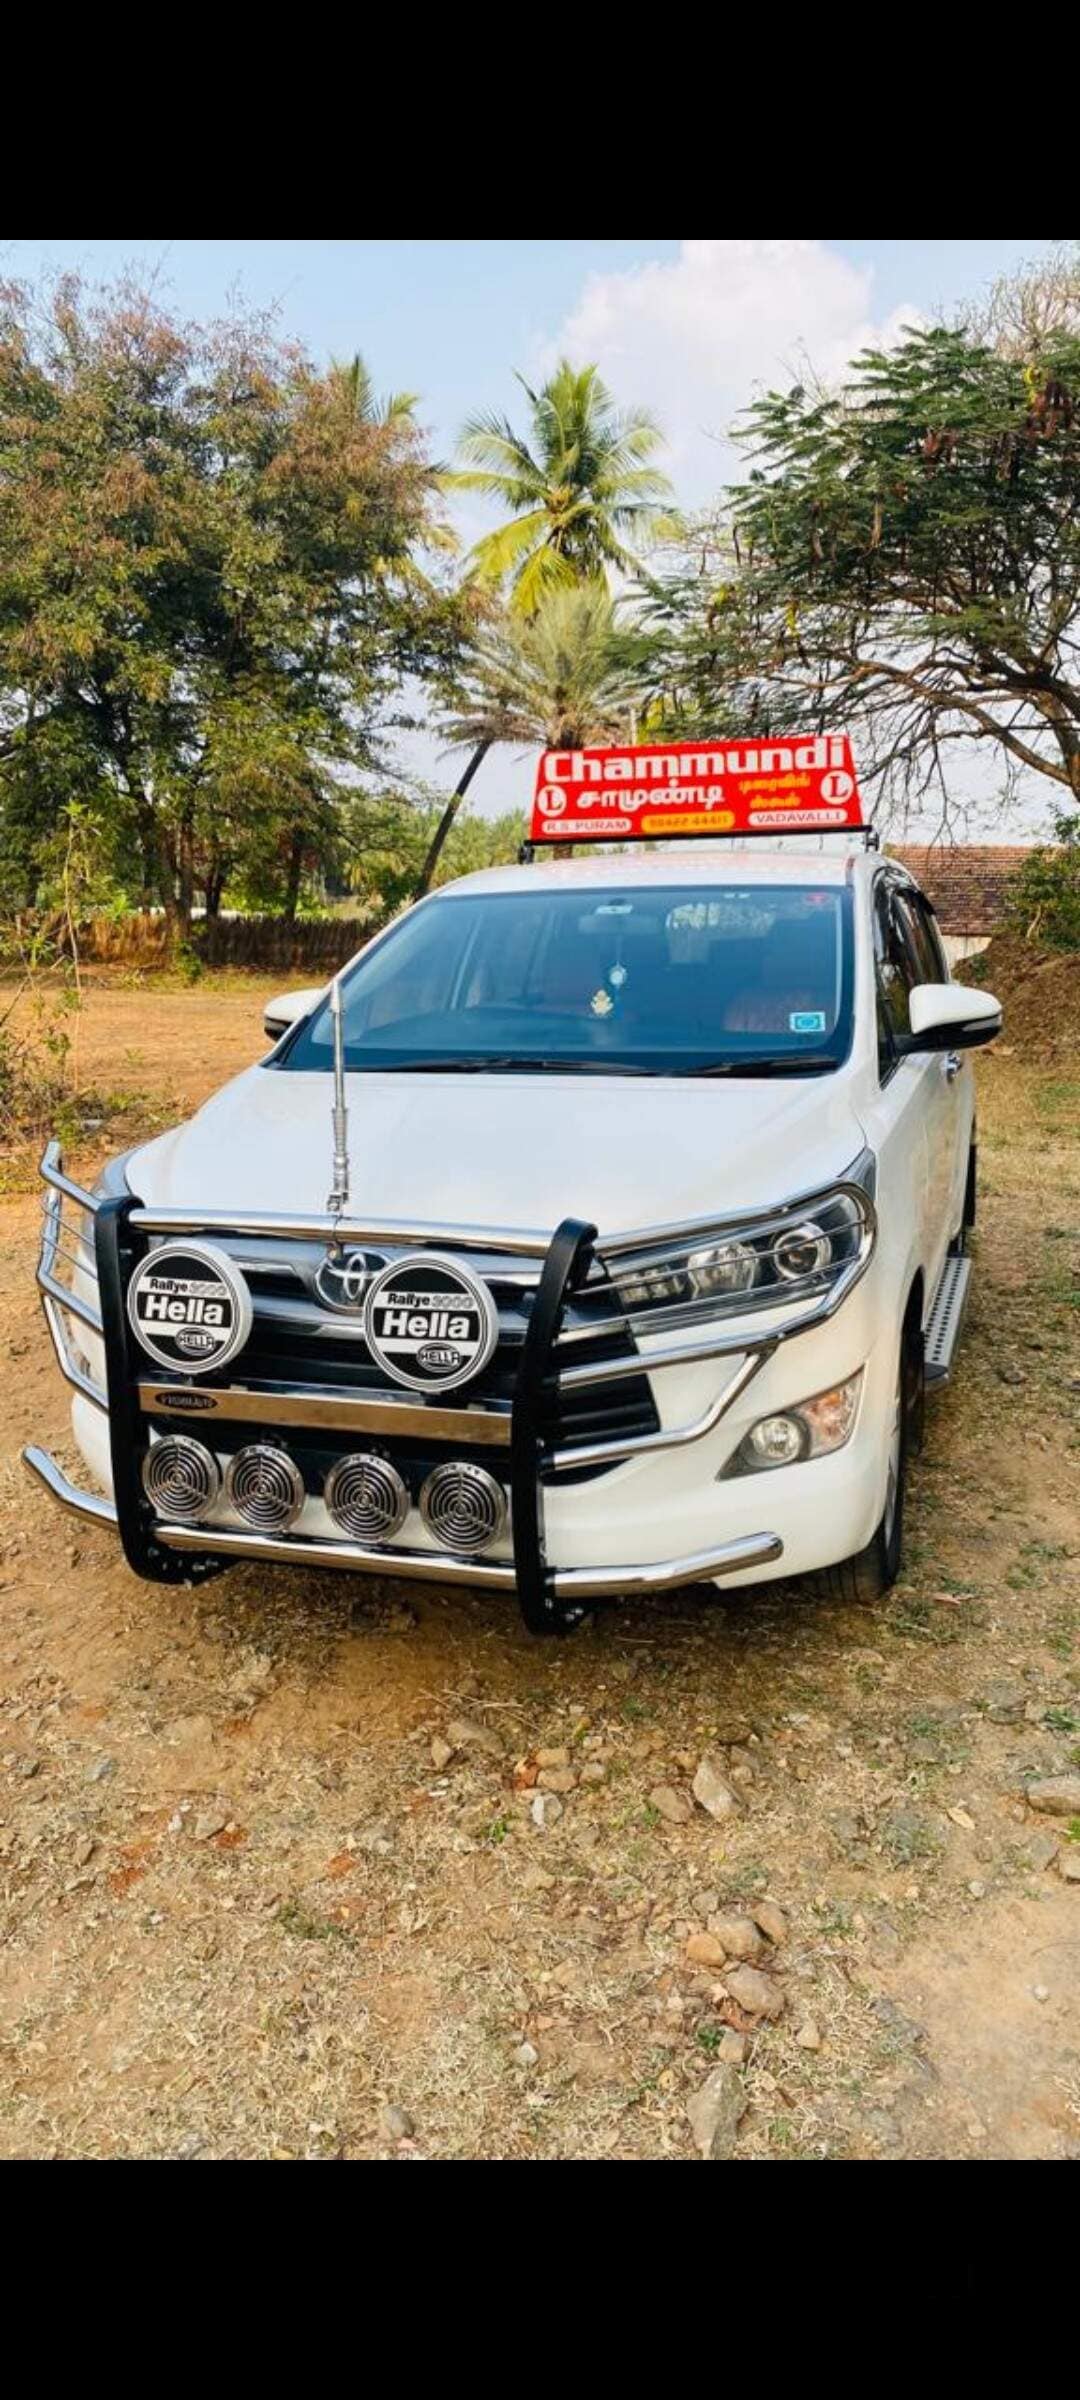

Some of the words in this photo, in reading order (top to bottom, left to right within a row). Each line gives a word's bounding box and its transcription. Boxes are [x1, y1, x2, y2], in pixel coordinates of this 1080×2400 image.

[544, 737, 844, 783] Chammundi
[576, 778, 725, 812] சாமுண்டி
[755, 811, 842, 824] VADAVALLI
[150, 1278, 188, 1294] Rallye
[387, 1292, 430, 1308] Rallye
[144, 1294, 224, 1326] Hella
[381, 1309, 470, 1339] Hella
[177, 1335, 214, 1349] HELLA
[419, 1350, 461, 1364] HELLA
